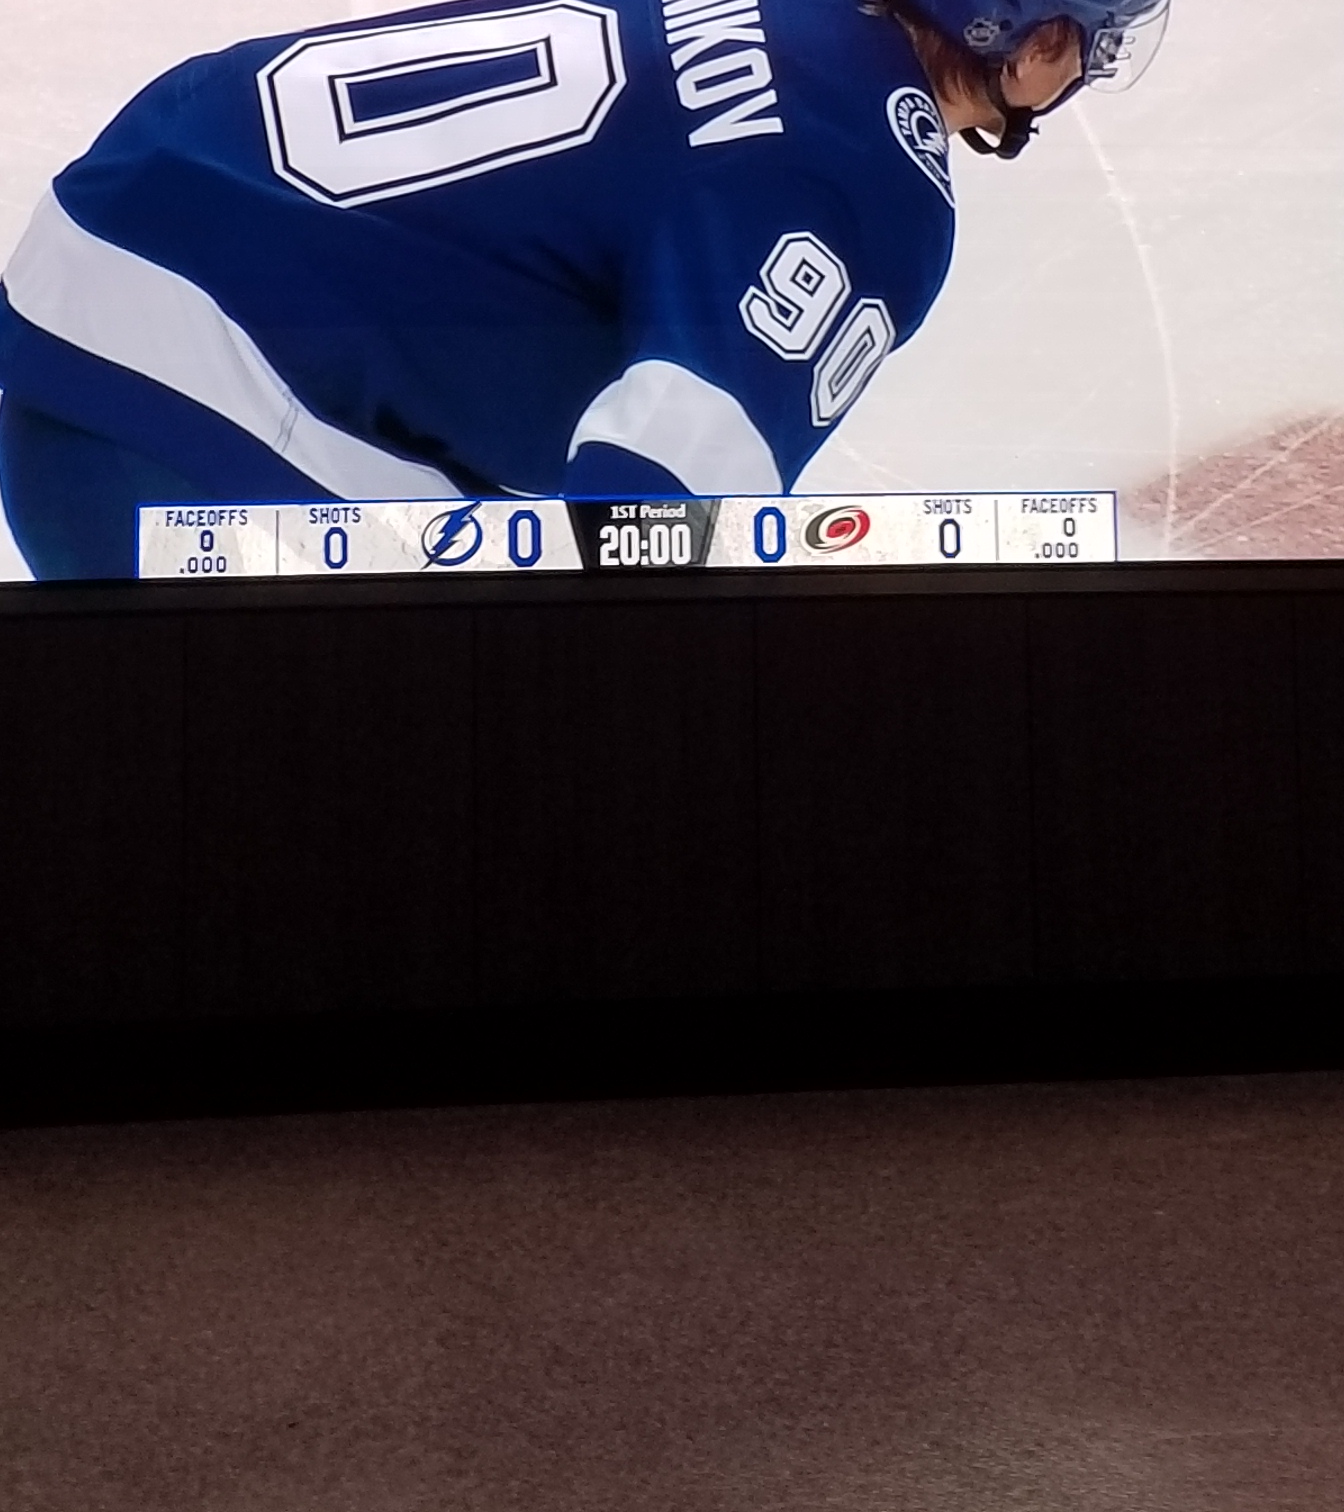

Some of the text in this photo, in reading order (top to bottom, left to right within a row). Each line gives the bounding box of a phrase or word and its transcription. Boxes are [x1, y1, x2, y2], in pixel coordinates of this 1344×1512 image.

[738, 231, 896, 427] 90
[308, 506, 362, 525] SHOTS
[610, 503, 686, 519] 1ST Period
[923, 498, 973, 515] SHOTS
[1020, 498, 1098, 514] FACEOFFS
[165, 509, 249, 527] FACEOFFS
[1063, 517, 1076, 538] 0
[200, 529, 215, 552] 0
[507, 509, 543, 568] 0
[599, 523, 692, 566] 20:00
[754, 506, 787, 564] 0
[938, 518, 962, 559] 0
[324, 526, 349, 570] 0
